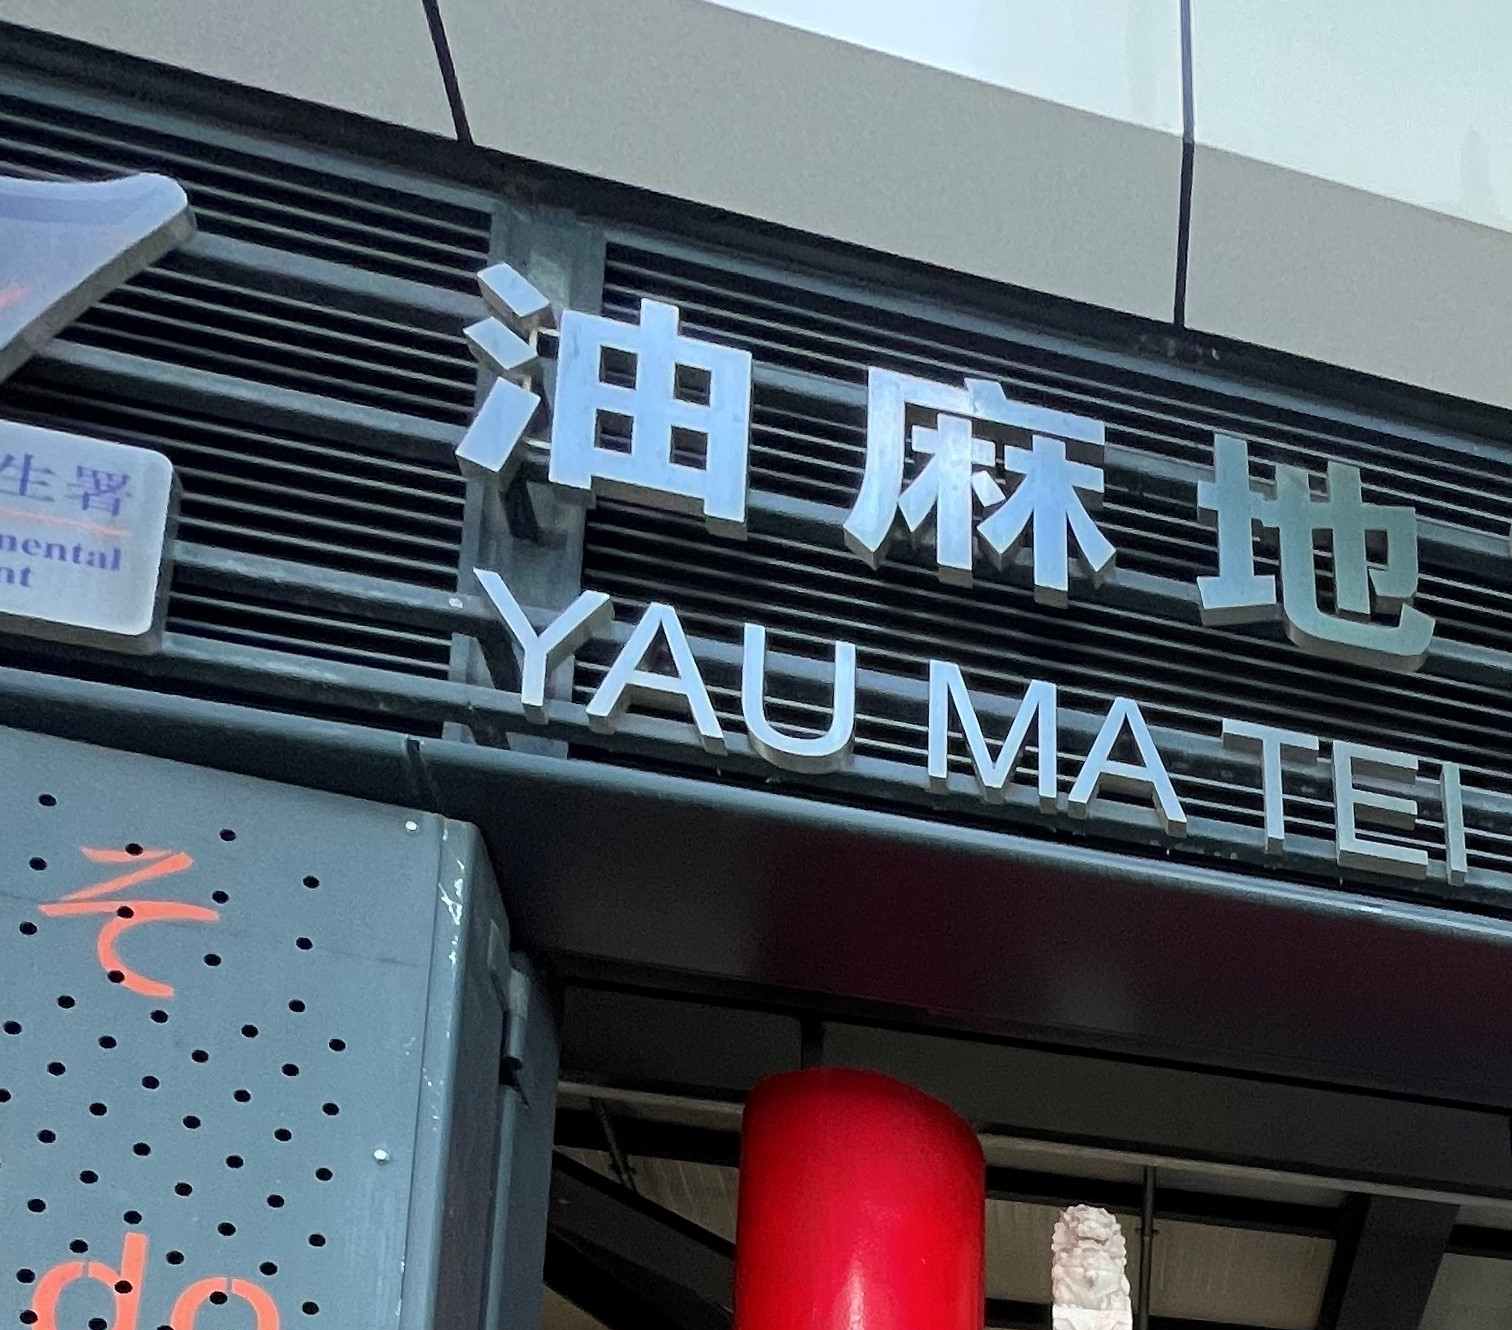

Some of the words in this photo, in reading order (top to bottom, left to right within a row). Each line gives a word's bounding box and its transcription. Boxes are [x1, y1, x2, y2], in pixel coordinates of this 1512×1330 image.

[0, 454, 132, 517] 生署
[473, 567, 856, 773] YAU
[926, 660, 1188, 838] MA
[1222, 716, 1467, 887] TEI
